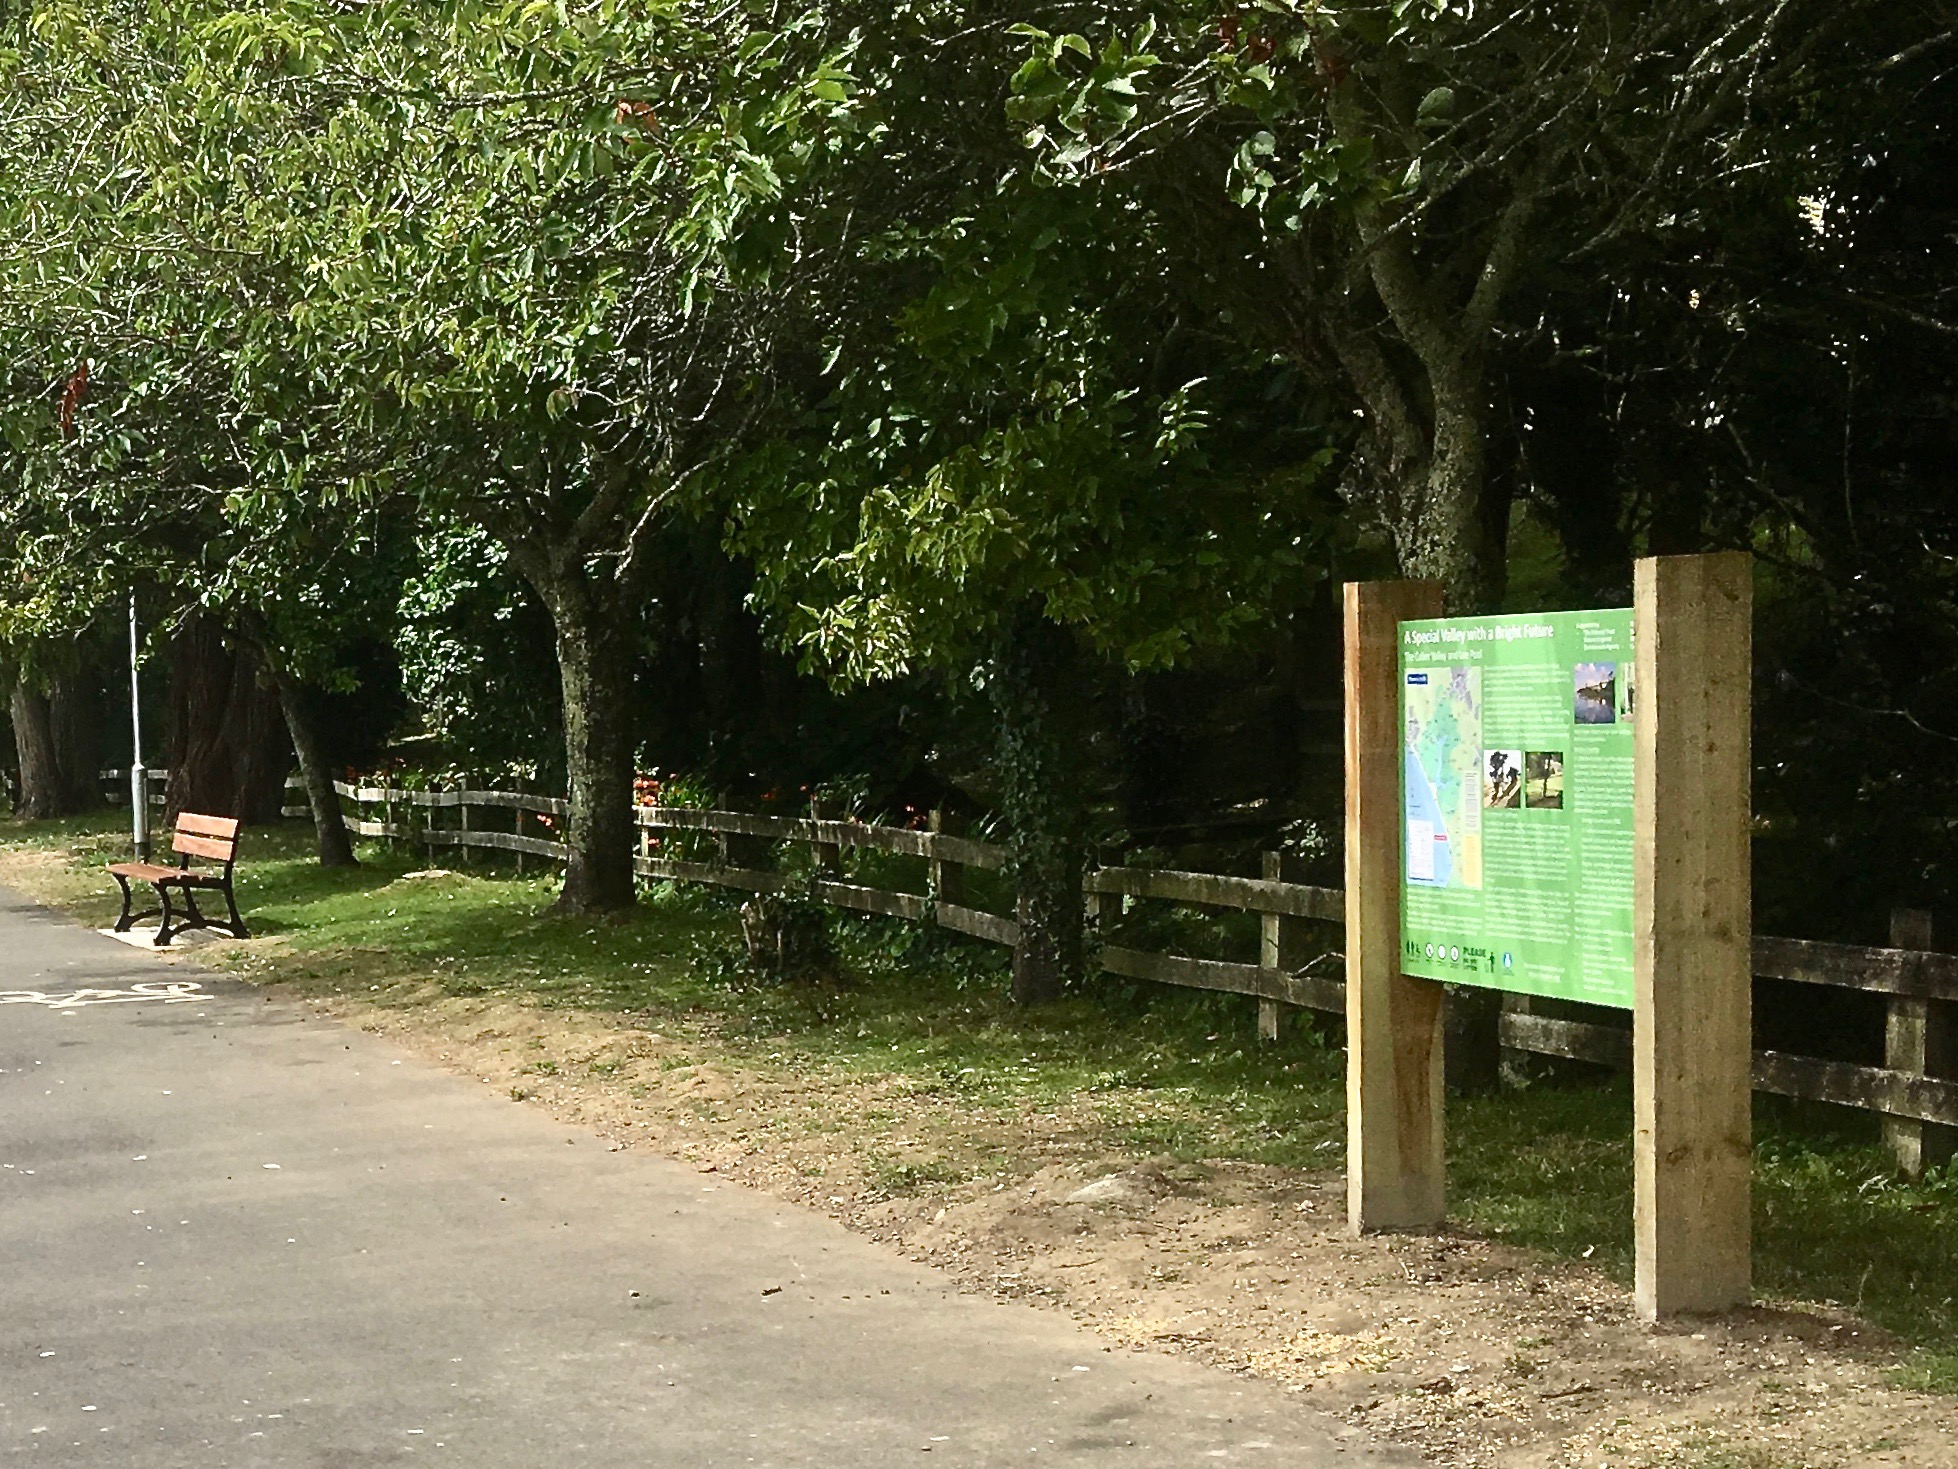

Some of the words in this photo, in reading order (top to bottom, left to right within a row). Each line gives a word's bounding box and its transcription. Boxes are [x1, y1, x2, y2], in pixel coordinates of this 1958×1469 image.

[1411, 629, 1440, 646] Special
[1440, 627, 1465, 644] Valley
[1466, 626, 1486, 641] with
[1487, 629, 1494, 640] a
[1495, 625, 1523, 643] Bright
[1523, 624, 1554, 638] Future
